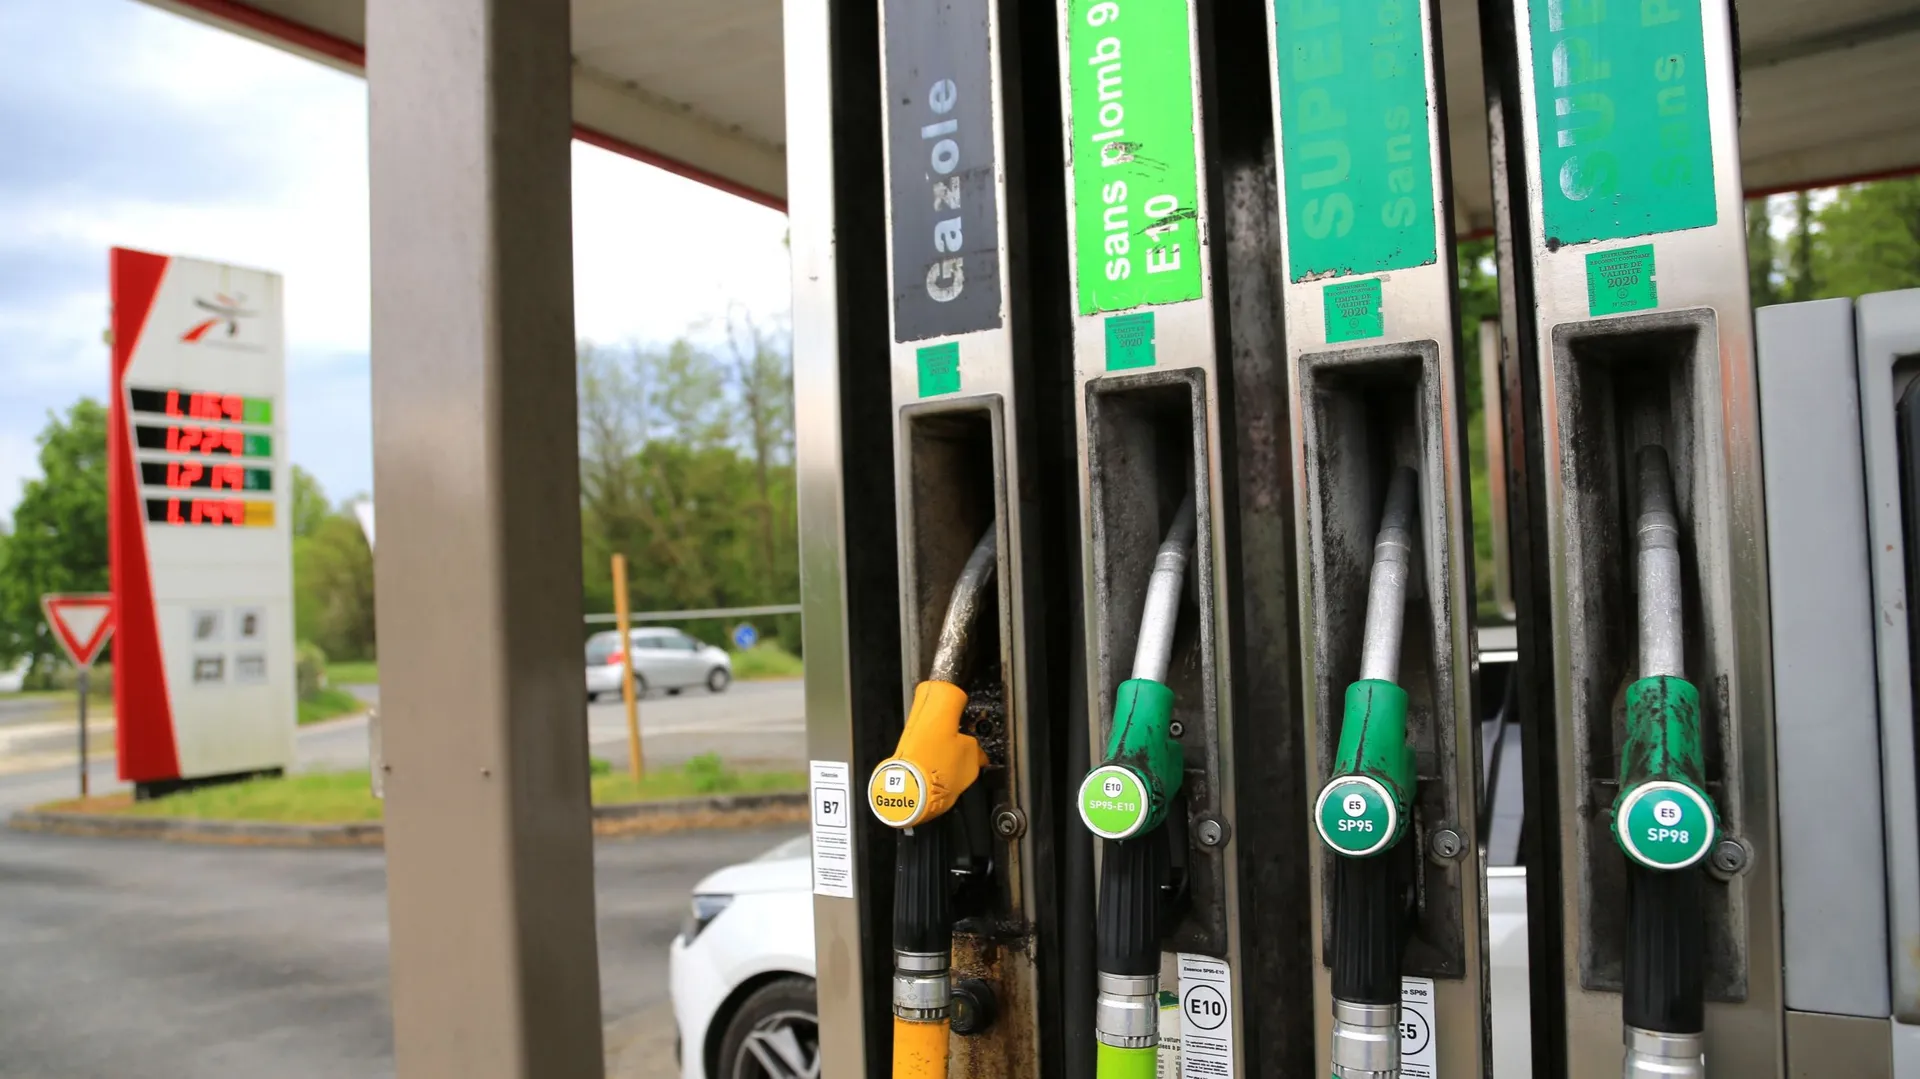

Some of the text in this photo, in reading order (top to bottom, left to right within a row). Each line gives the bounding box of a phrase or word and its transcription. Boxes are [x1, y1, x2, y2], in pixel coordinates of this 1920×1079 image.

[1088, 36, 1135, 168] plomb
[921, 78, 964, 303] Gazole
[1101, 179, 1131, 282] sans
[1144, 193, 1182, 275] E10
[1599, 260, 1643, 272] LIMITE DE
[1607, 274, 1638, 288] 2020
[1341, 306, 1368, 318] 2020
[889, 777, 901, 786] B7
[1105, 783, 1121, 792] E10
[823, 800, 839, 814] B7
[876, 795, 915, 808] Gazole
[1089, 799, 1135, 812] SP95-E10
[1349, 801, 1361, 810] E5
[1661, 808, 1675, 818] E5
[1338, 819, 1373, 832] SP95
[1647, 828, 1689, 844] SP98
[1191, 998, 1221, 1016] E10
